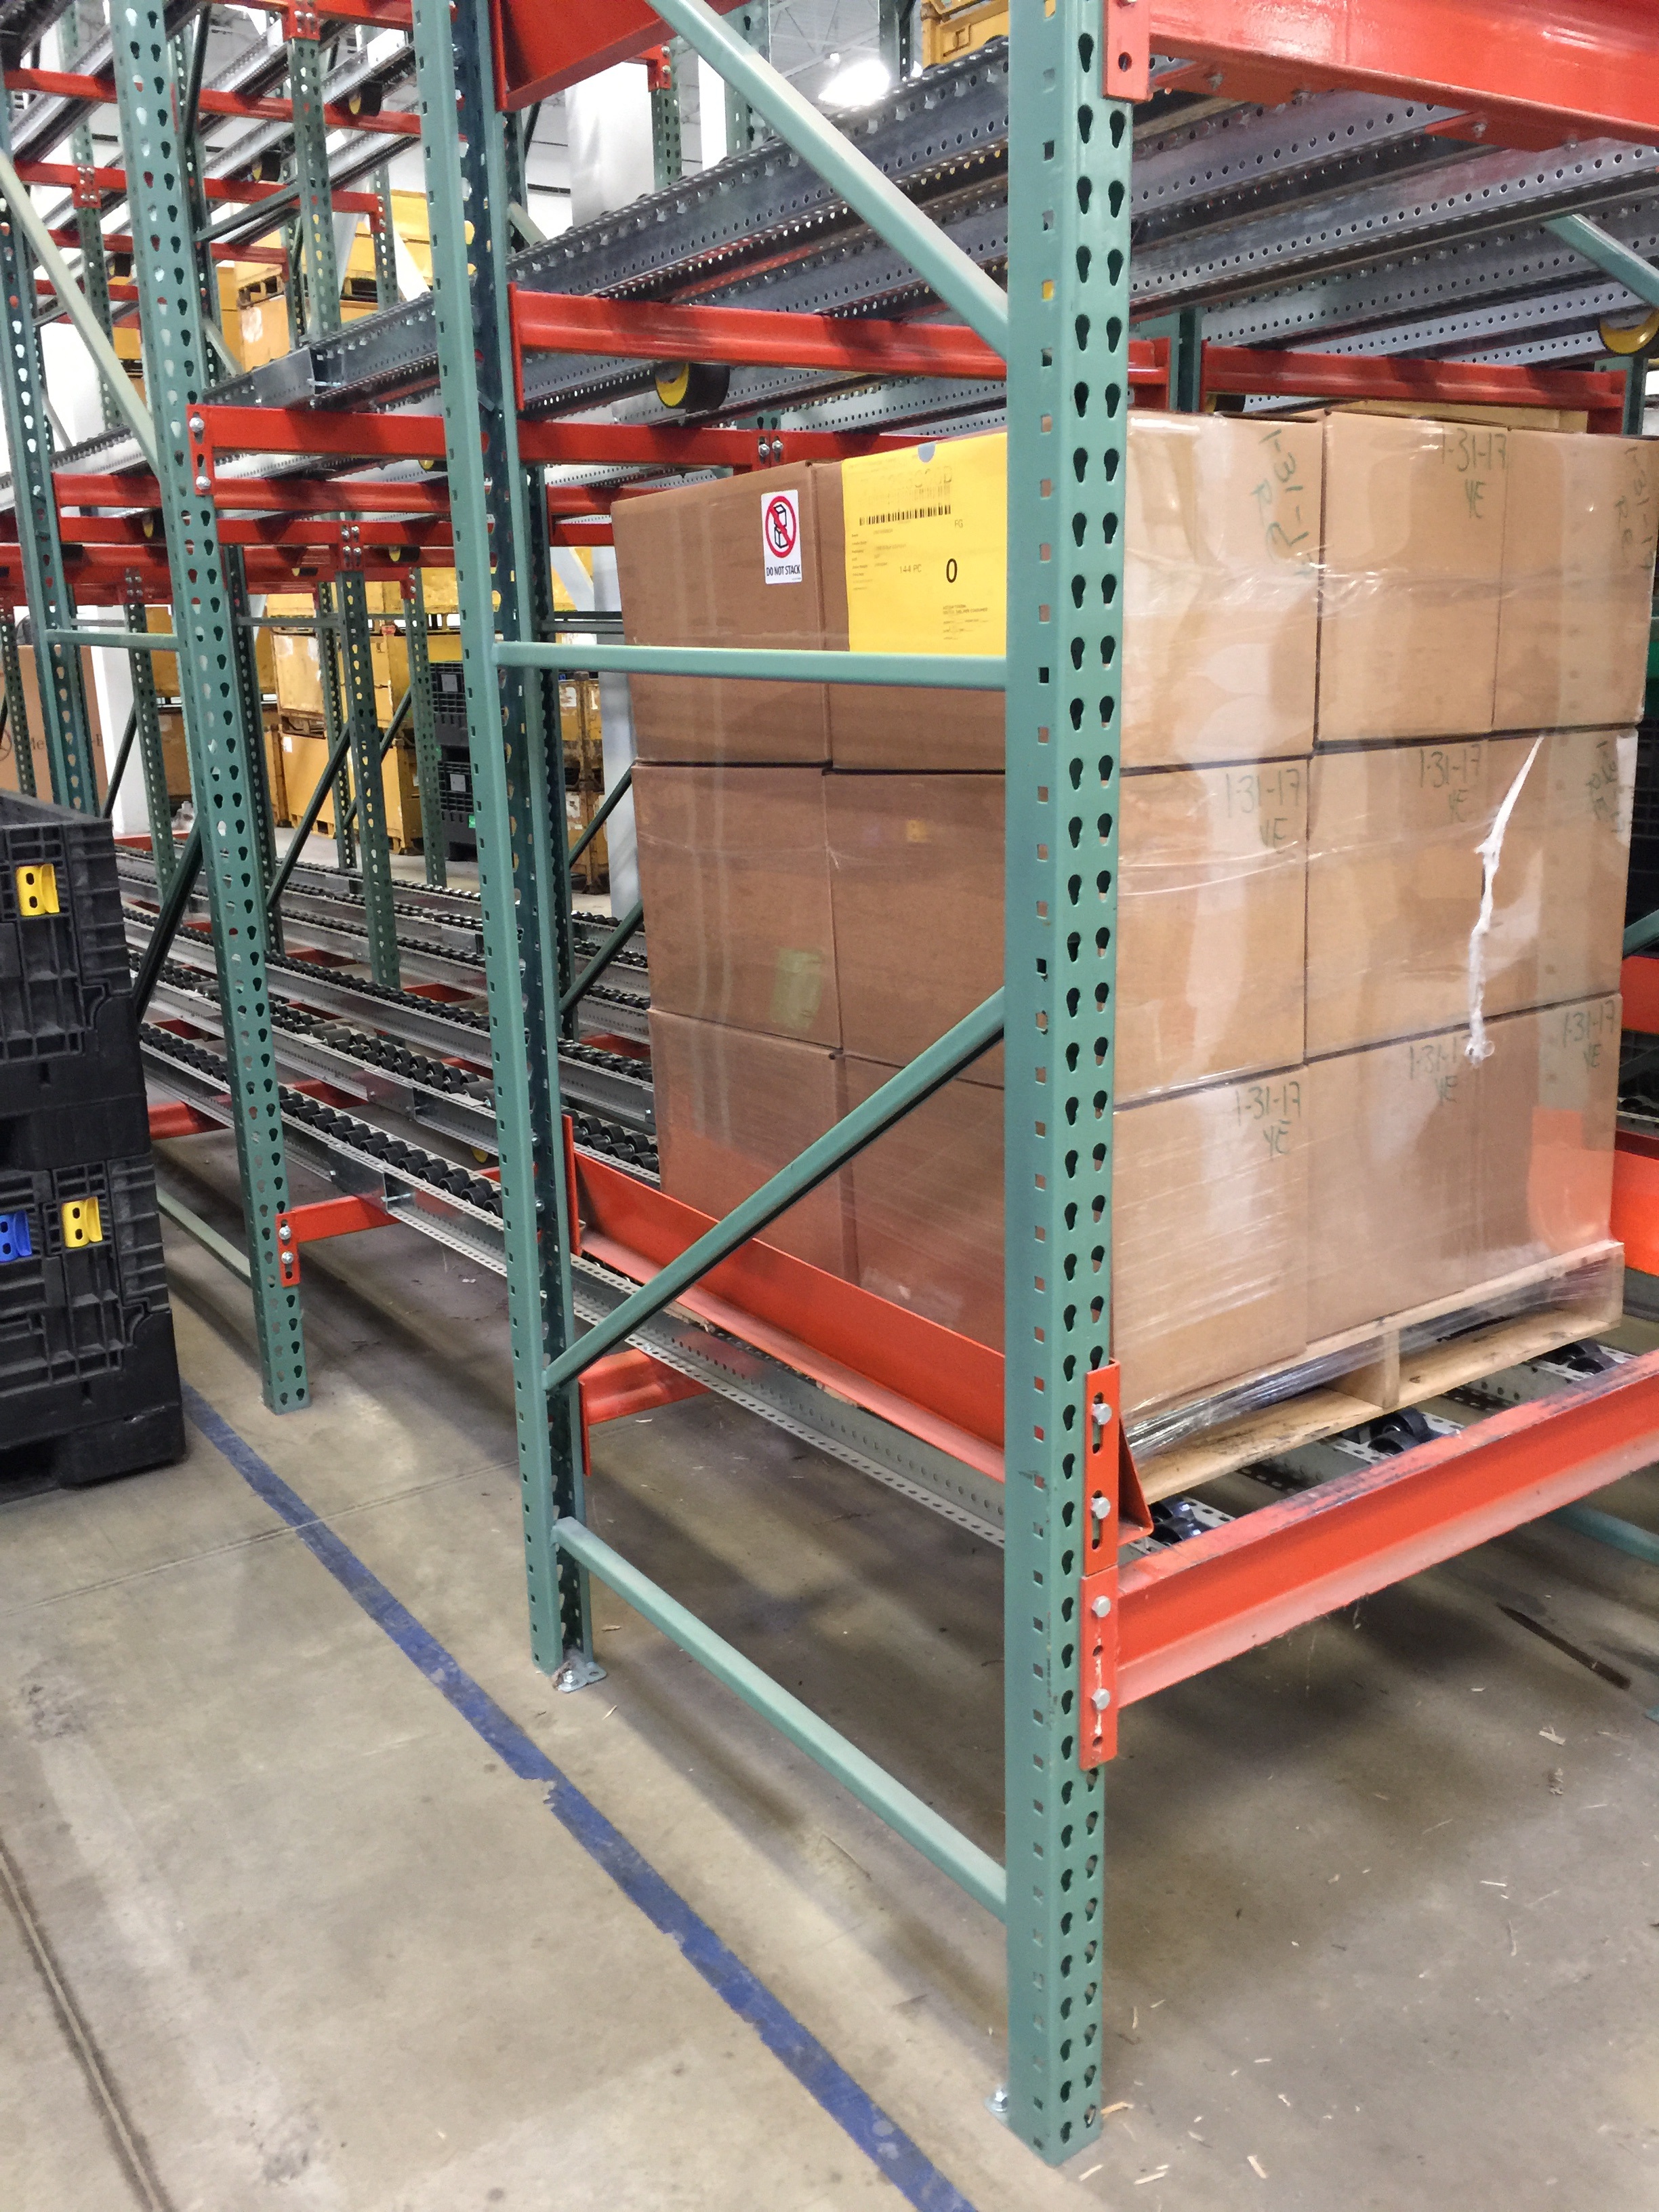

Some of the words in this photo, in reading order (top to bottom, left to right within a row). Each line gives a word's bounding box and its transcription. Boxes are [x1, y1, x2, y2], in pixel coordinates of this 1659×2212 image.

[954, 519, 963, 528] FG
[766, 567, 774, 577] DO
[775, 565, 785, 576] NOT
[785, 564, 801, 575] STACK
[899, 565, 912, 574] 144
[913, 563, 922, 573] PC
[946, 558, 958, 583] 0
[1235, 1081, 1300, 1126] 1-31-17
